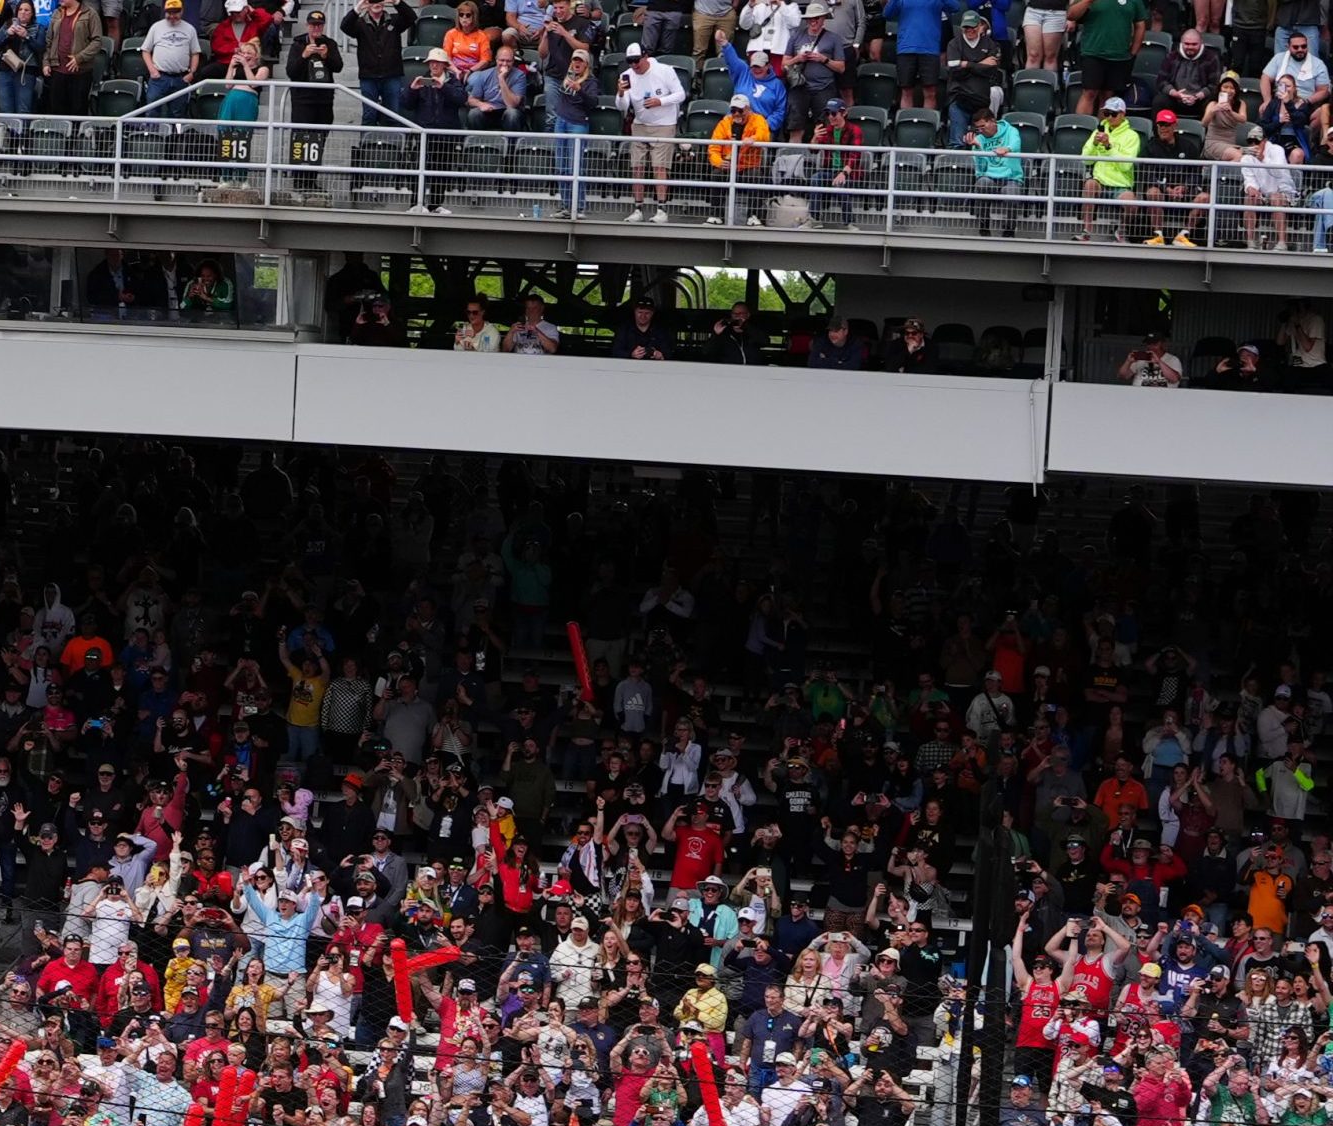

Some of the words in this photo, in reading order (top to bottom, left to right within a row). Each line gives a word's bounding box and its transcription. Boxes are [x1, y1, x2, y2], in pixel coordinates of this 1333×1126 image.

[222, 140, 230, 157] BOX
[231, 140, 247, 158] 15
[292, 142, 302, 160] BOX
[303, 142, 318, 162] 16
[948, 919, 958, 927] 13
[1032, 1005, 1050, 1018] 25
